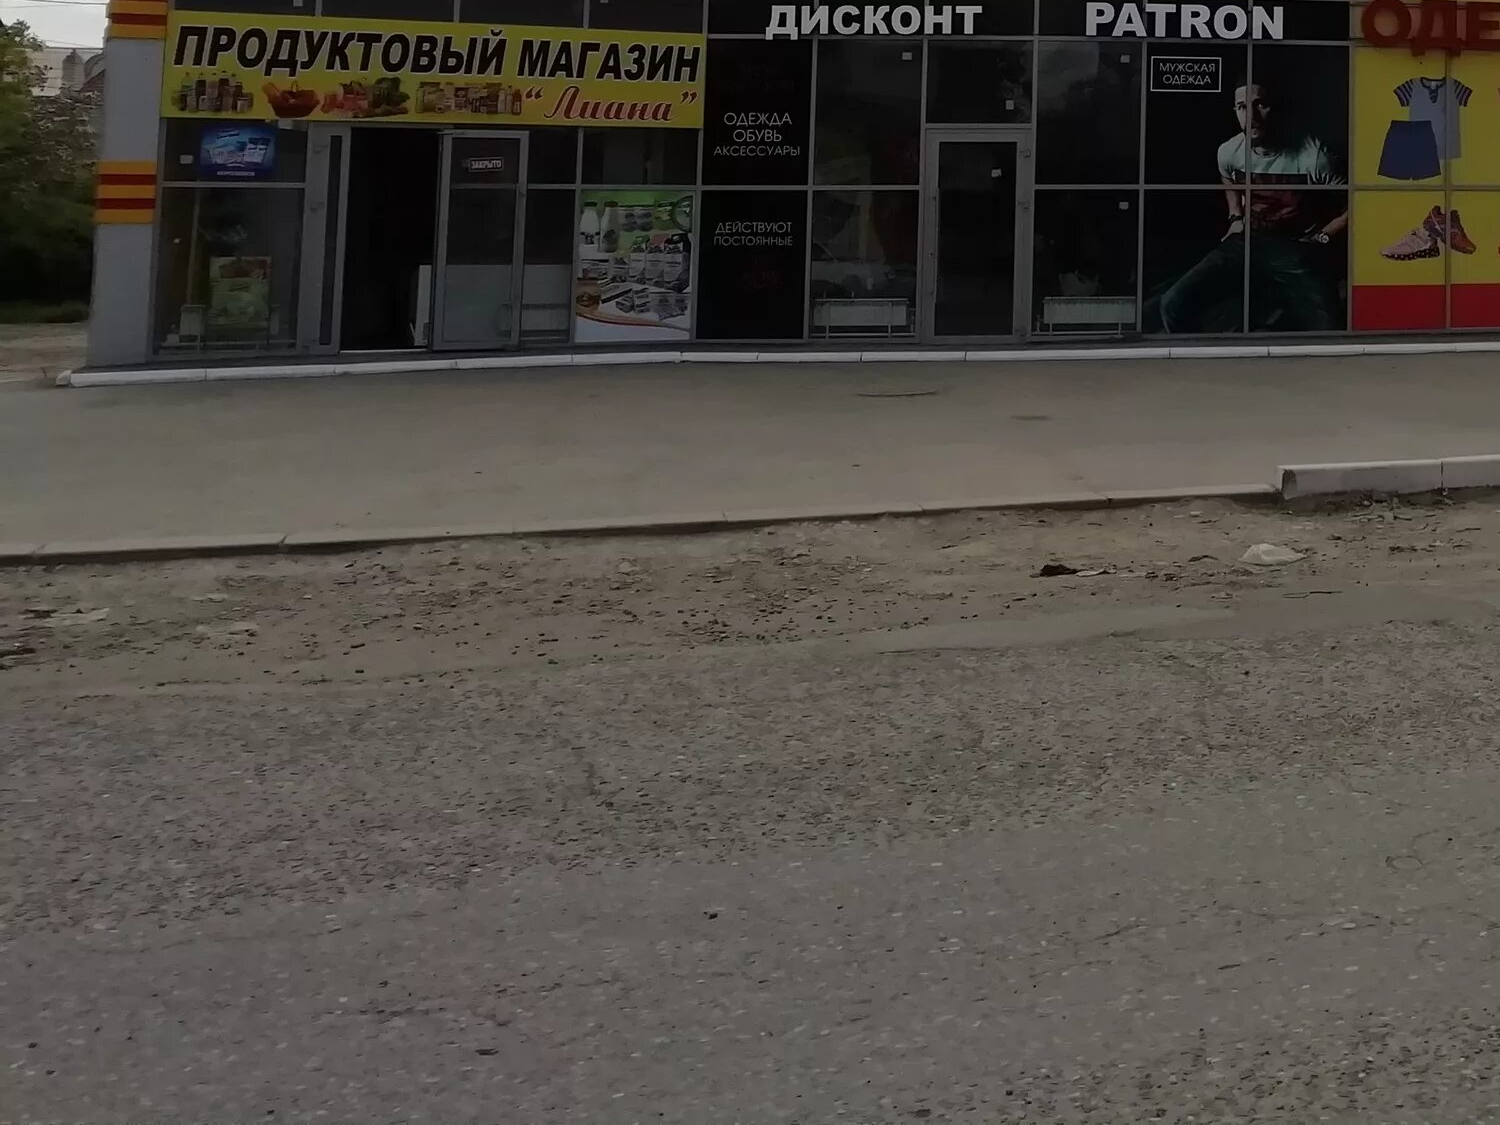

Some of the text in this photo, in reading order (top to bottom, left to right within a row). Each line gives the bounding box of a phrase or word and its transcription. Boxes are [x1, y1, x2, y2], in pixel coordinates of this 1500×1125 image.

[765, 4, 983, 41] ДИСКОНТ
[1084, 1, 1284, 41] PATRON
[173, 24, 701, 83] ПРОДУКТОВЫЙ МАГАЗИН
[1159, 62, 1216, 73] МУЖСКАЯ
[1162, 74, 1212, 86] ОДЕЖДА
[723, 112, 793, 128] ОДЕЖДА
[732, 129, 783, 142] ОБУВЬ
[713, 145, 801, 157] АКСЕССУАРЫ
[715, 219, 793, 235] ДЕЙСТВУЮТ
[713, 235, 793, 247] ПОСТОЯННЫЕ
